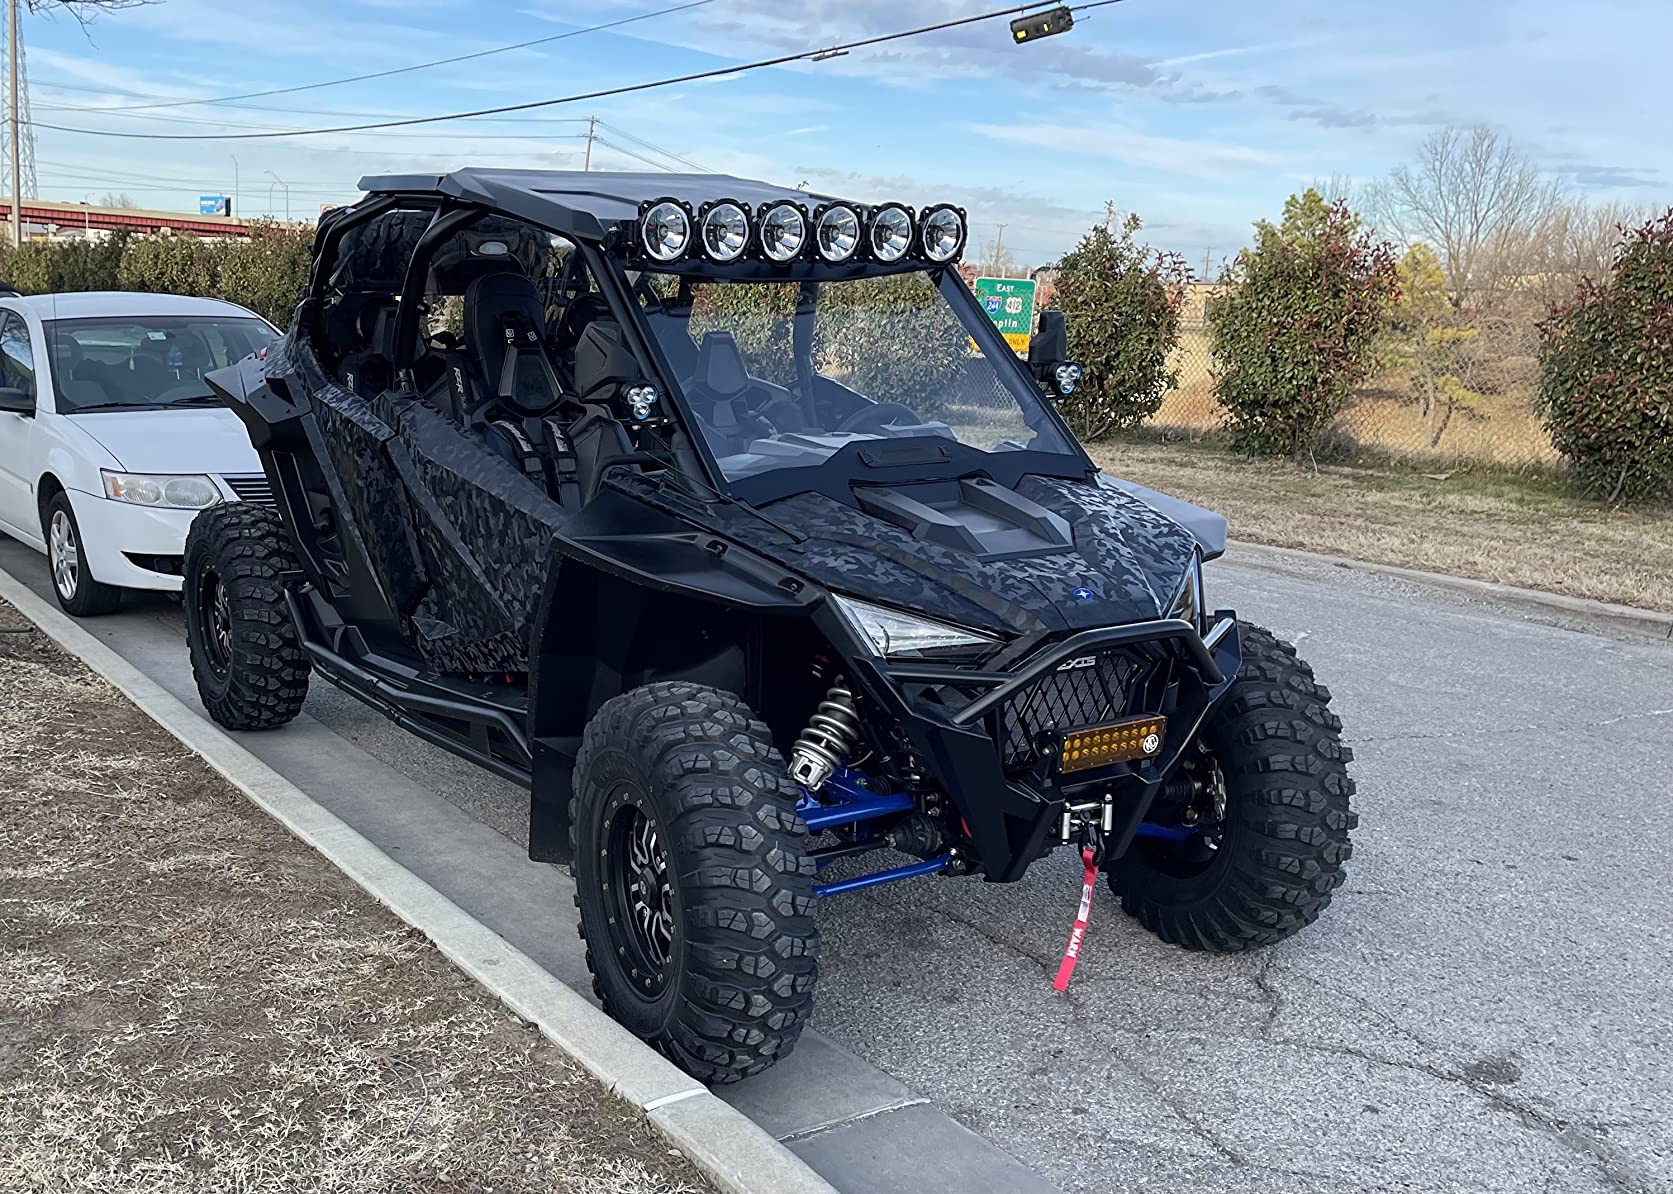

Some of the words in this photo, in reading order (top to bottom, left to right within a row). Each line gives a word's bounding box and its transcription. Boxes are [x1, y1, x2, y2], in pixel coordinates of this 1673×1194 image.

[996, 283, 1014, 293] EAST
[1006, 300, 1021, 310] 412
[1144, 735, 1157, 751] KC
[1066, 927, 1083, 958] WARN
